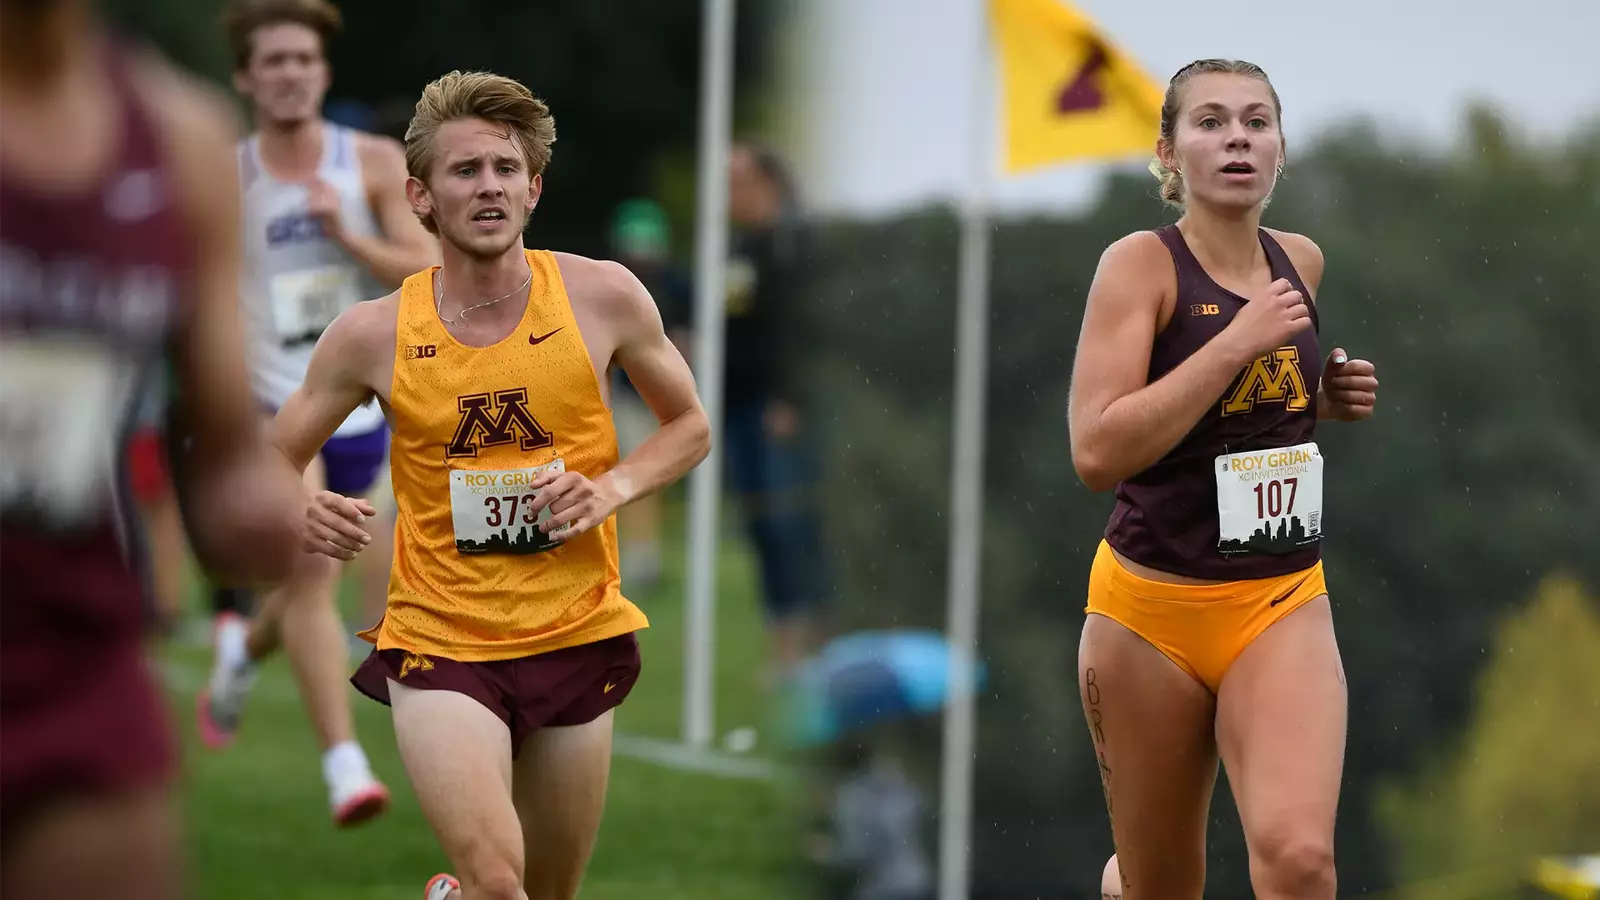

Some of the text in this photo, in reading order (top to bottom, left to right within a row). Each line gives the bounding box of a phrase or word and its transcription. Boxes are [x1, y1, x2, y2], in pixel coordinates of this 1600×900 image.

[1221, 346, 1311, 417] M
[445, 387, 553, 459] M
[1231, 448, 1312, 473] ROY GRIAK
[1238, 466, 1309, 483] XC INVITATIONAL
[465, 466, 549, 487] ROY GRIA
[485, 484, 535, 496] INVITATIO
[484, 494, 539, 527] 373
[1253, 477, 1298, 519] 107
